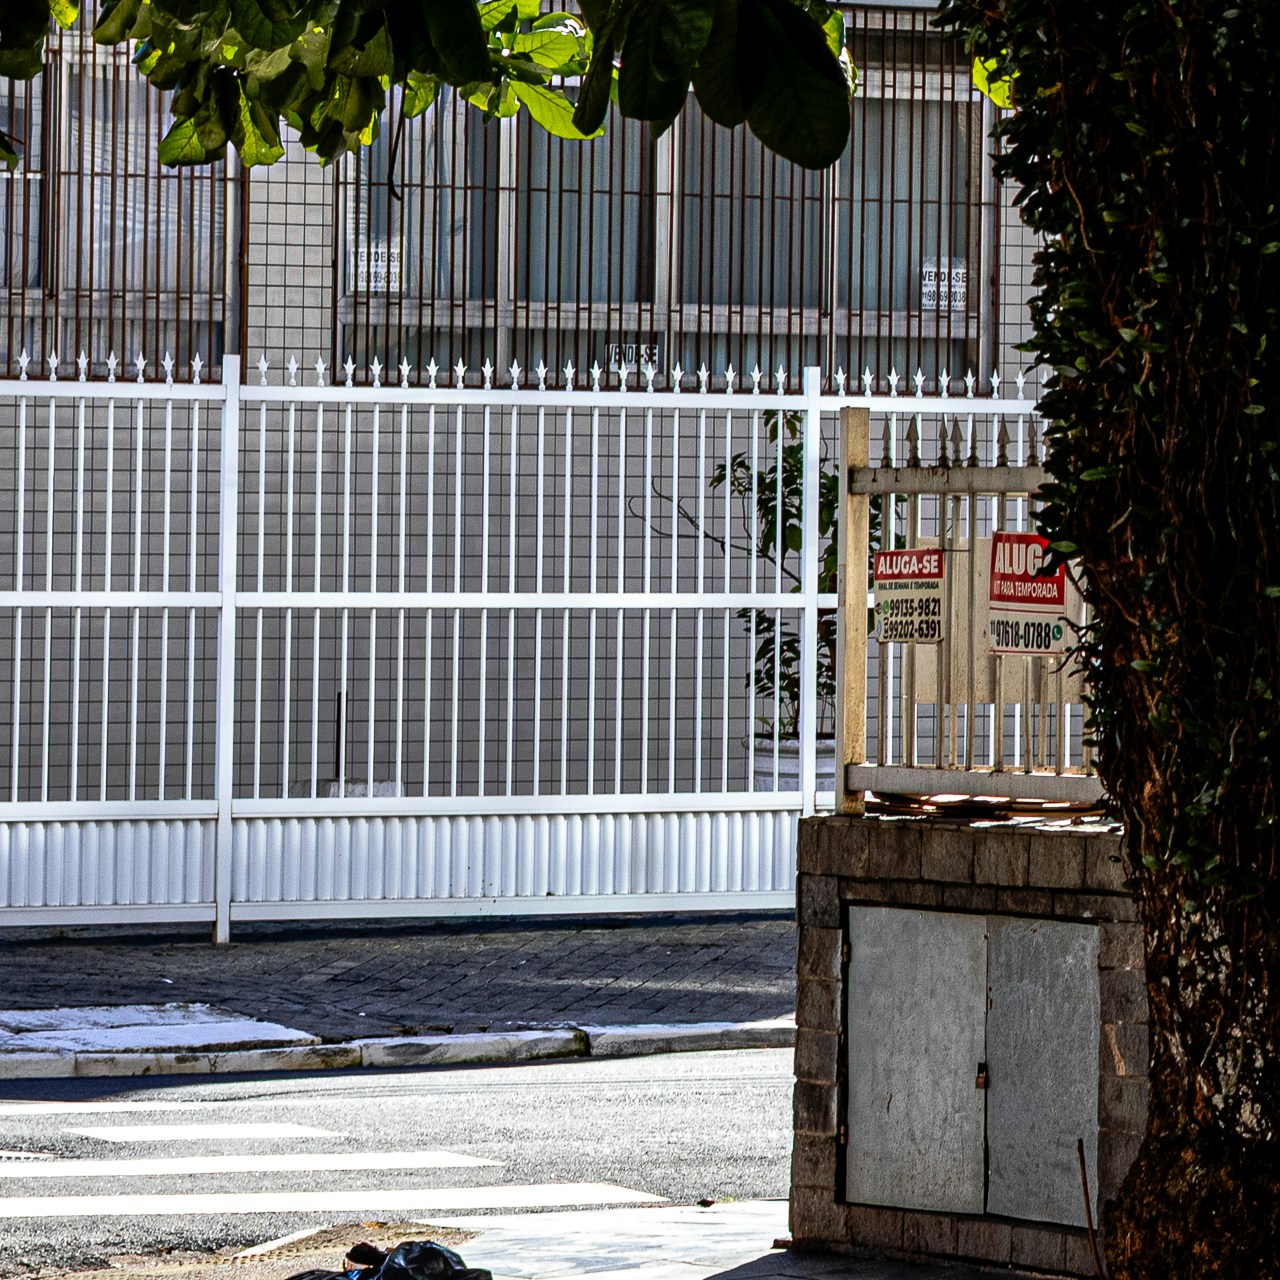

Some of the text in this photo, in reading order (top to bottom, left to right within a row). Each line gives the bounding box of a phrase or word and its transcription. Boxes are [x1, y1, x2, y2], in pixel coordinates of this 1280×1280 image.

[877, 554, 939, 575] ALUGA-SE
[1001, 581, 1014, 597] PARA
[1015, 582, 1059, 598] TEMPORADA
[889, 597, 942, 618] 99135-9821
[888, 618, 942, 639] 99202-6391
[995, 619, 1052, 650] 97618-0788
